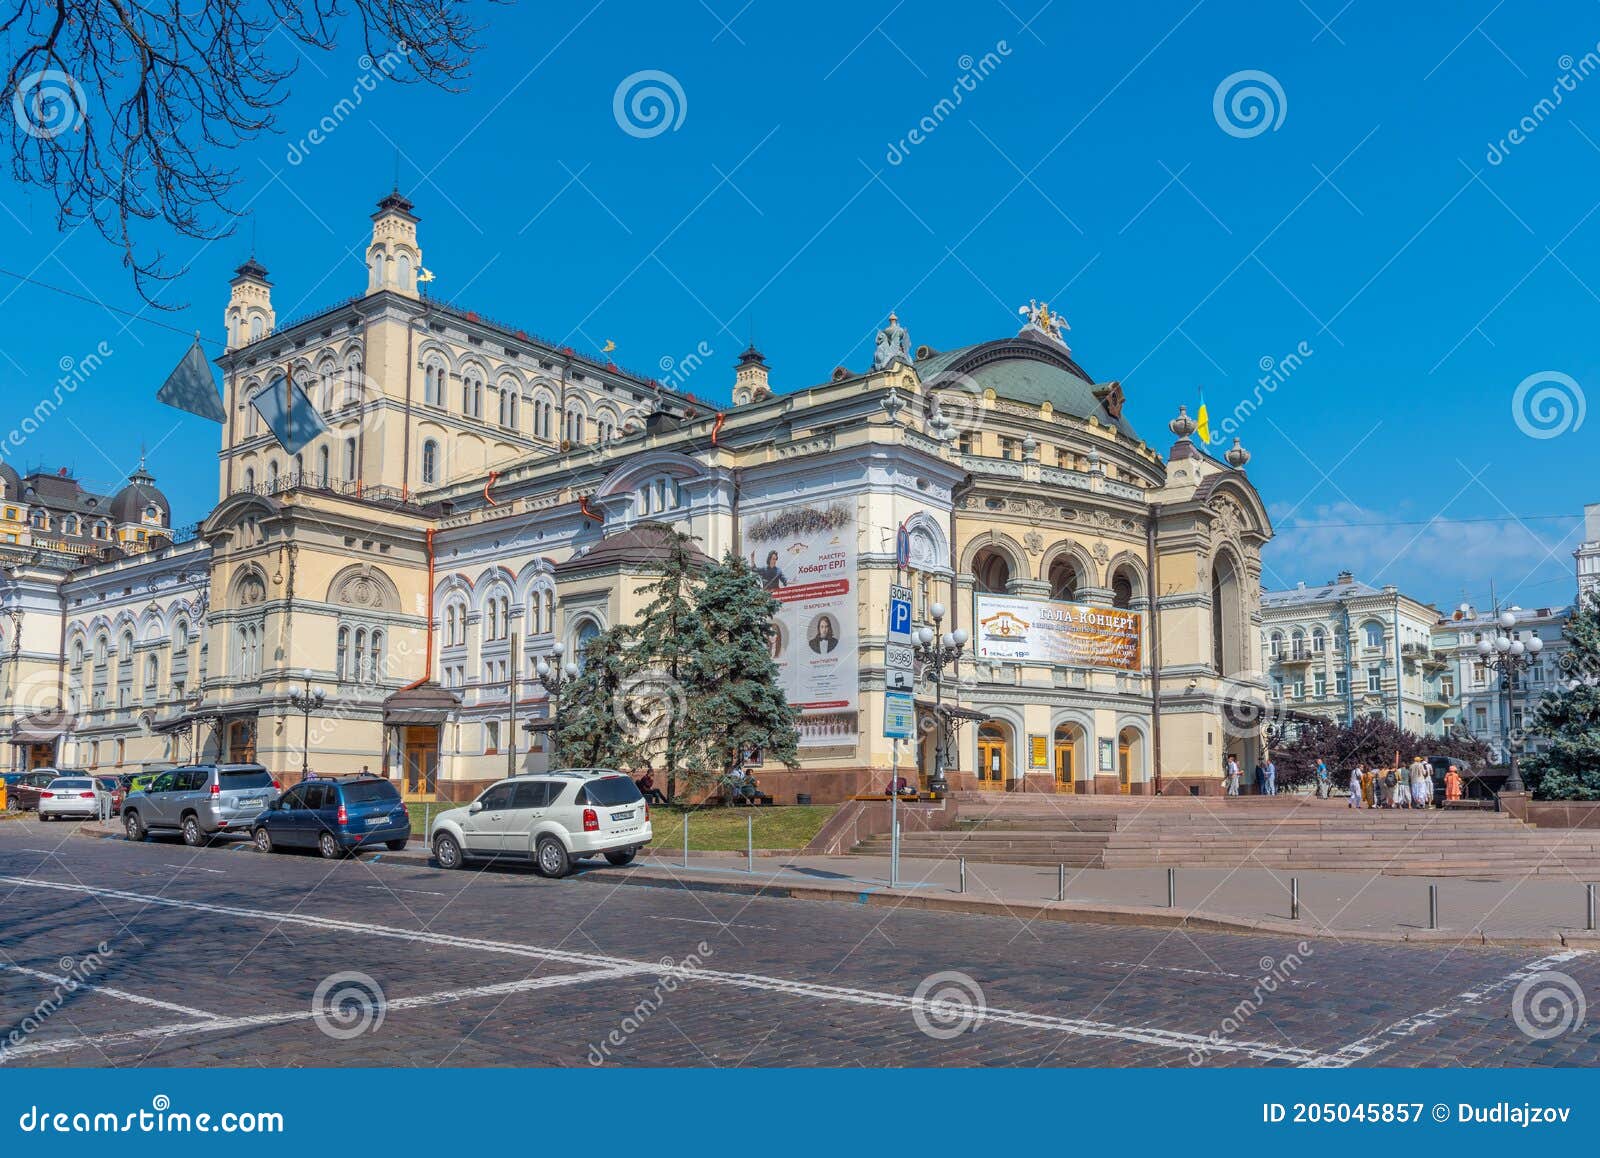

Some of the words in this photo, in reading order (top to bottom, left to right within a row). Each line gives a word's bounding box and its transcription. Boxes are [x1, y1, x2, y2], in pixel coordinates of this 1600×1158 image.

[798, 564, 827, 574] Хобарт
[829, 560, 846, 570] ЕРЛ
[892, 587, 912, 602] ЗОНА
[1040, 608, 1134, 630] ГАЛА-КОНЦЕРТ
